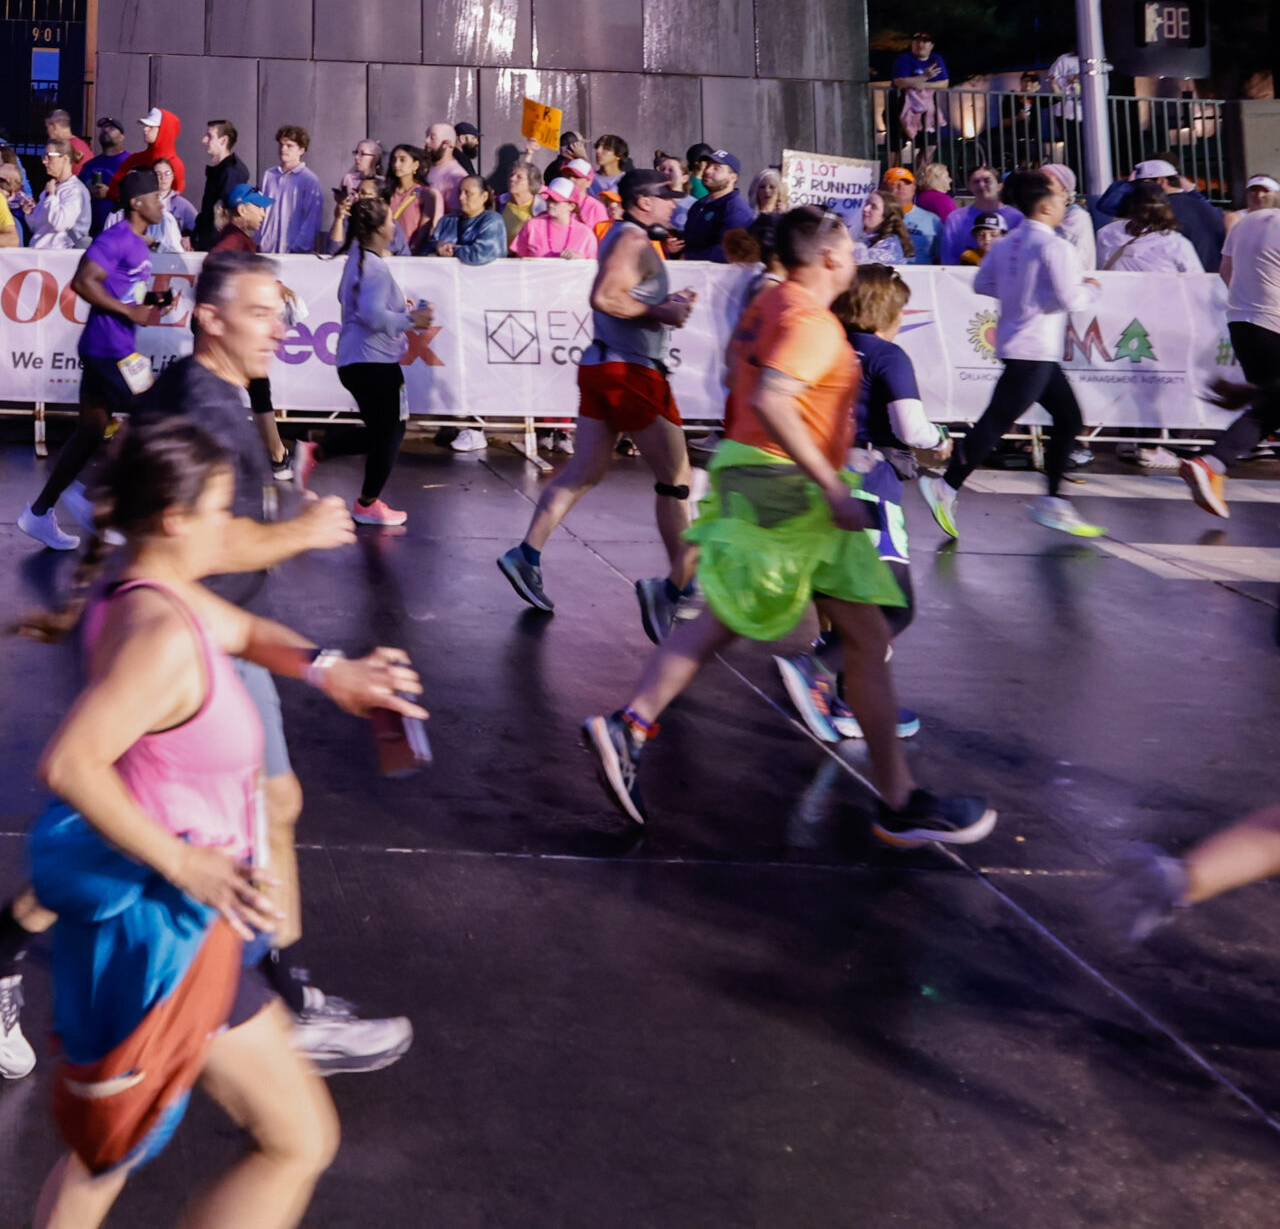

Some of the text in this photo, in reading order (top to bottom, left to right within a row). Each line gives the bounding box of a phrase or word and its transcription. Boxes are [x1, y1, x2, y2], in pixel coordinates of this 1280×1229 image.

[795, 161, 838, 177] A LOT
[811, 178, 876, 194] RUNNING
[790, 192, 863, 210] GOING ON
[11, 351, 44, 370] We
